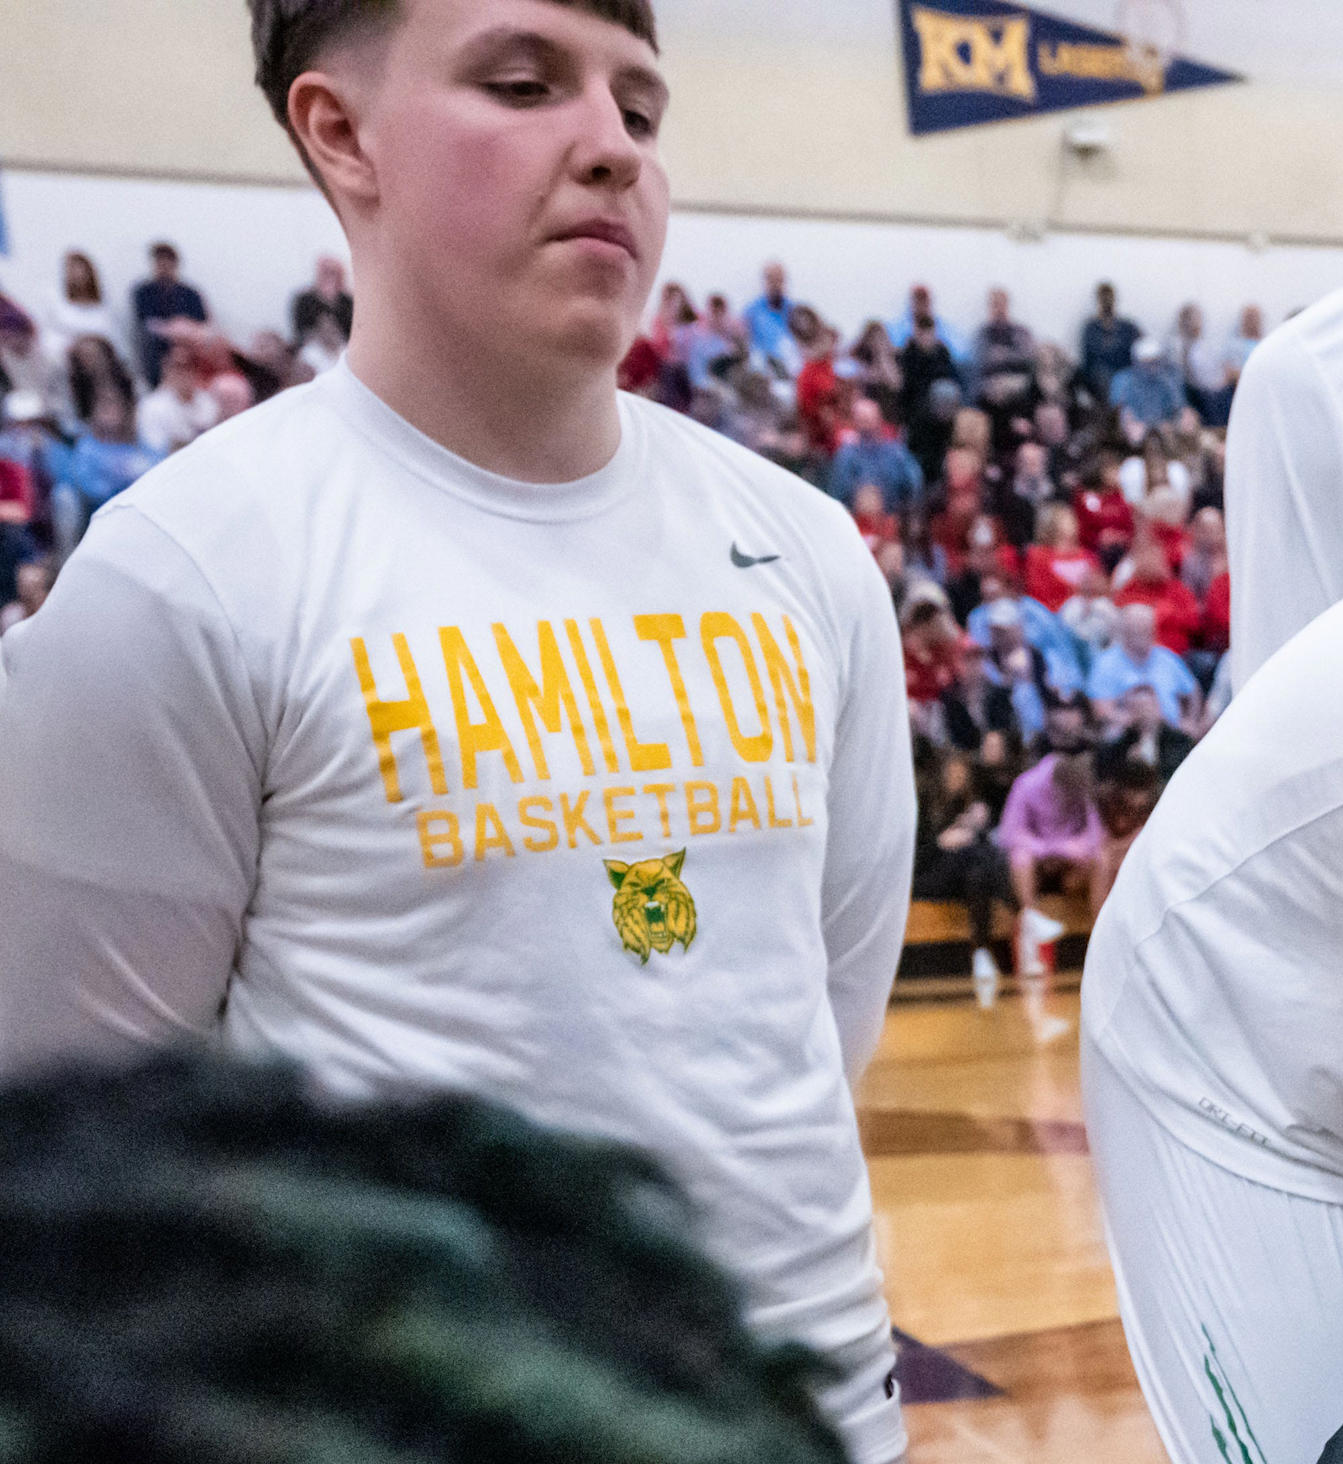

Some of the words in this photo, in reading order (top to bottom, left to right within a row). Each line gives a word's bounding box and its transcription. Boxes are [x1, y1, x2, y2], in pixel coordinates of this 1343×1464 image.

[910, 8, 1036, 104] KM
[350, 612, 816, 803] HAMILTON
[416, 774, 814, 869] BASKETBALL
